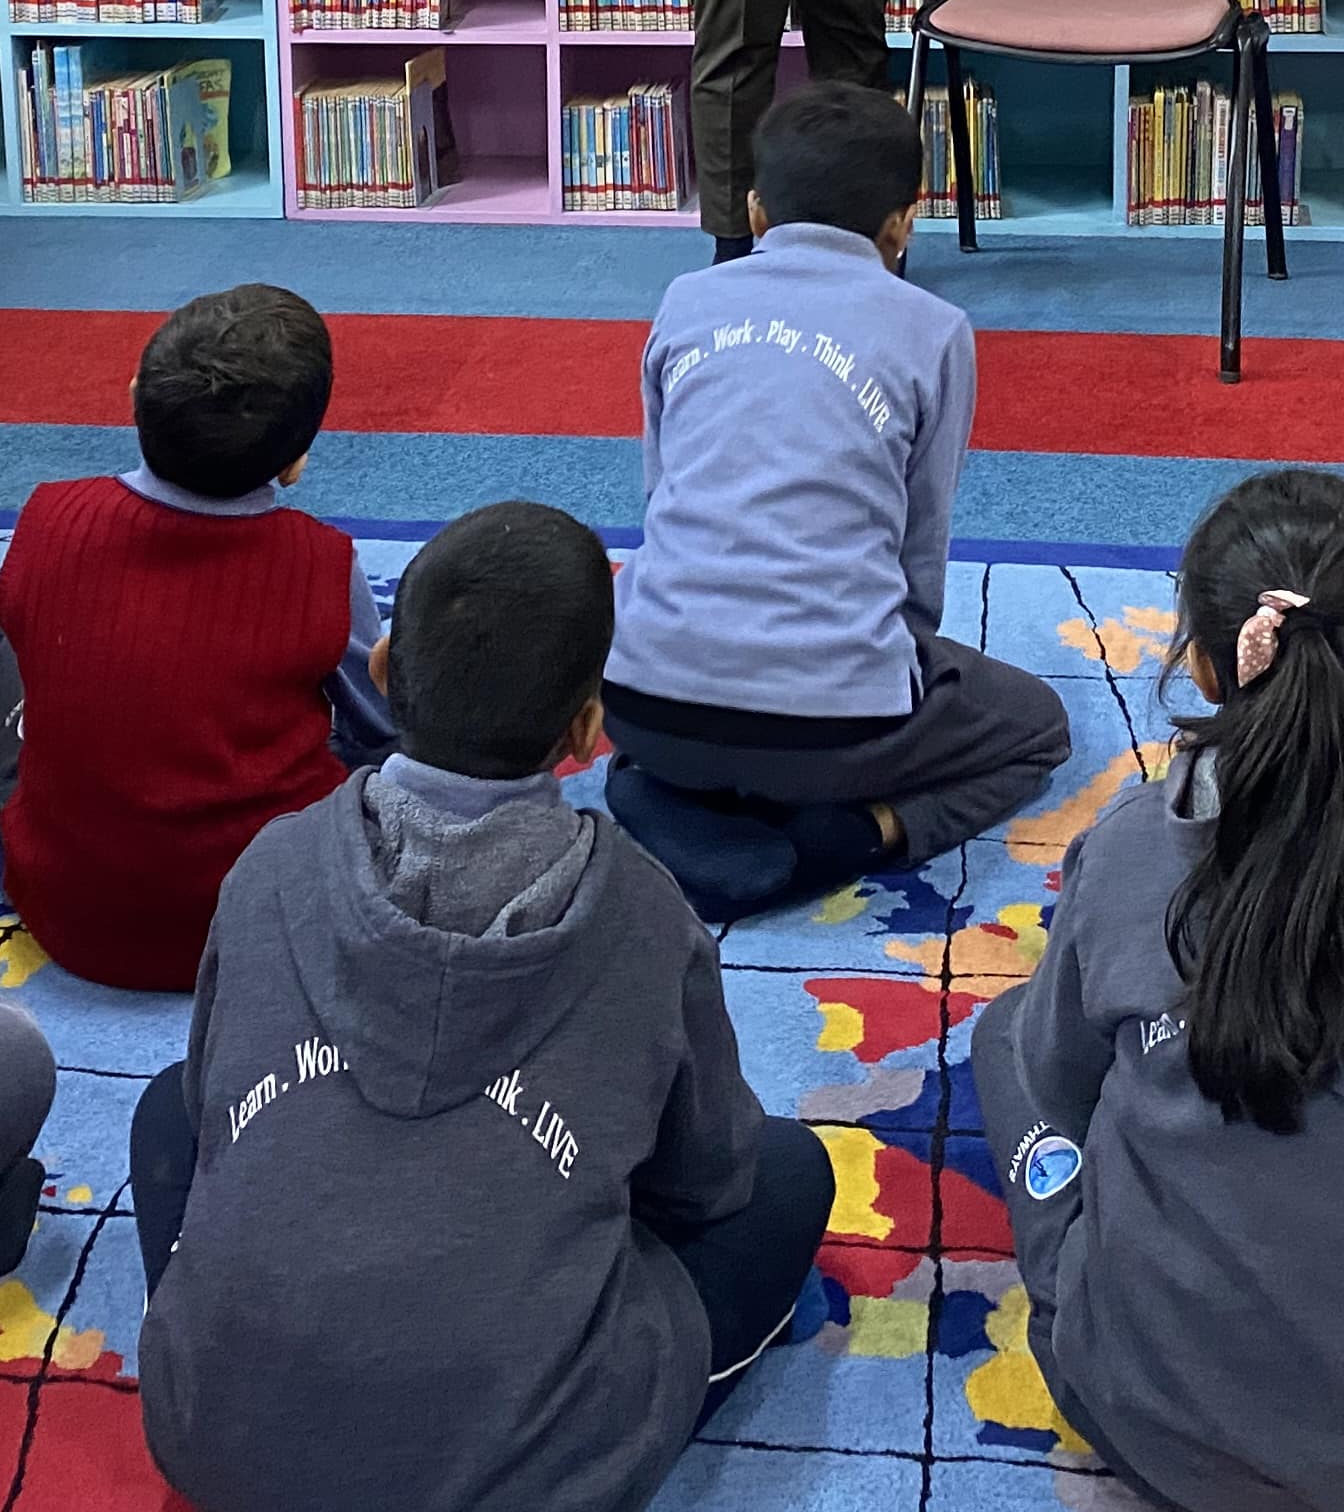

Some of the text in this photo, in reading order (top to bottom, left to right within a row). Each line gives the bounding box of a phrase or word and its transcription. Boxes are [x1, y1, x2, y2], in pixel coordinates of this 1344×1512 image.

[713, 318, 755, 353] Work
[766, 320, 802, 353] Play
[813, 334, 857, 382] Think
[857, 377, 891, 433] LIVE
[227, 1073, 277, 1144] Learn
[532, 1101, 580, 1180] LIVE
